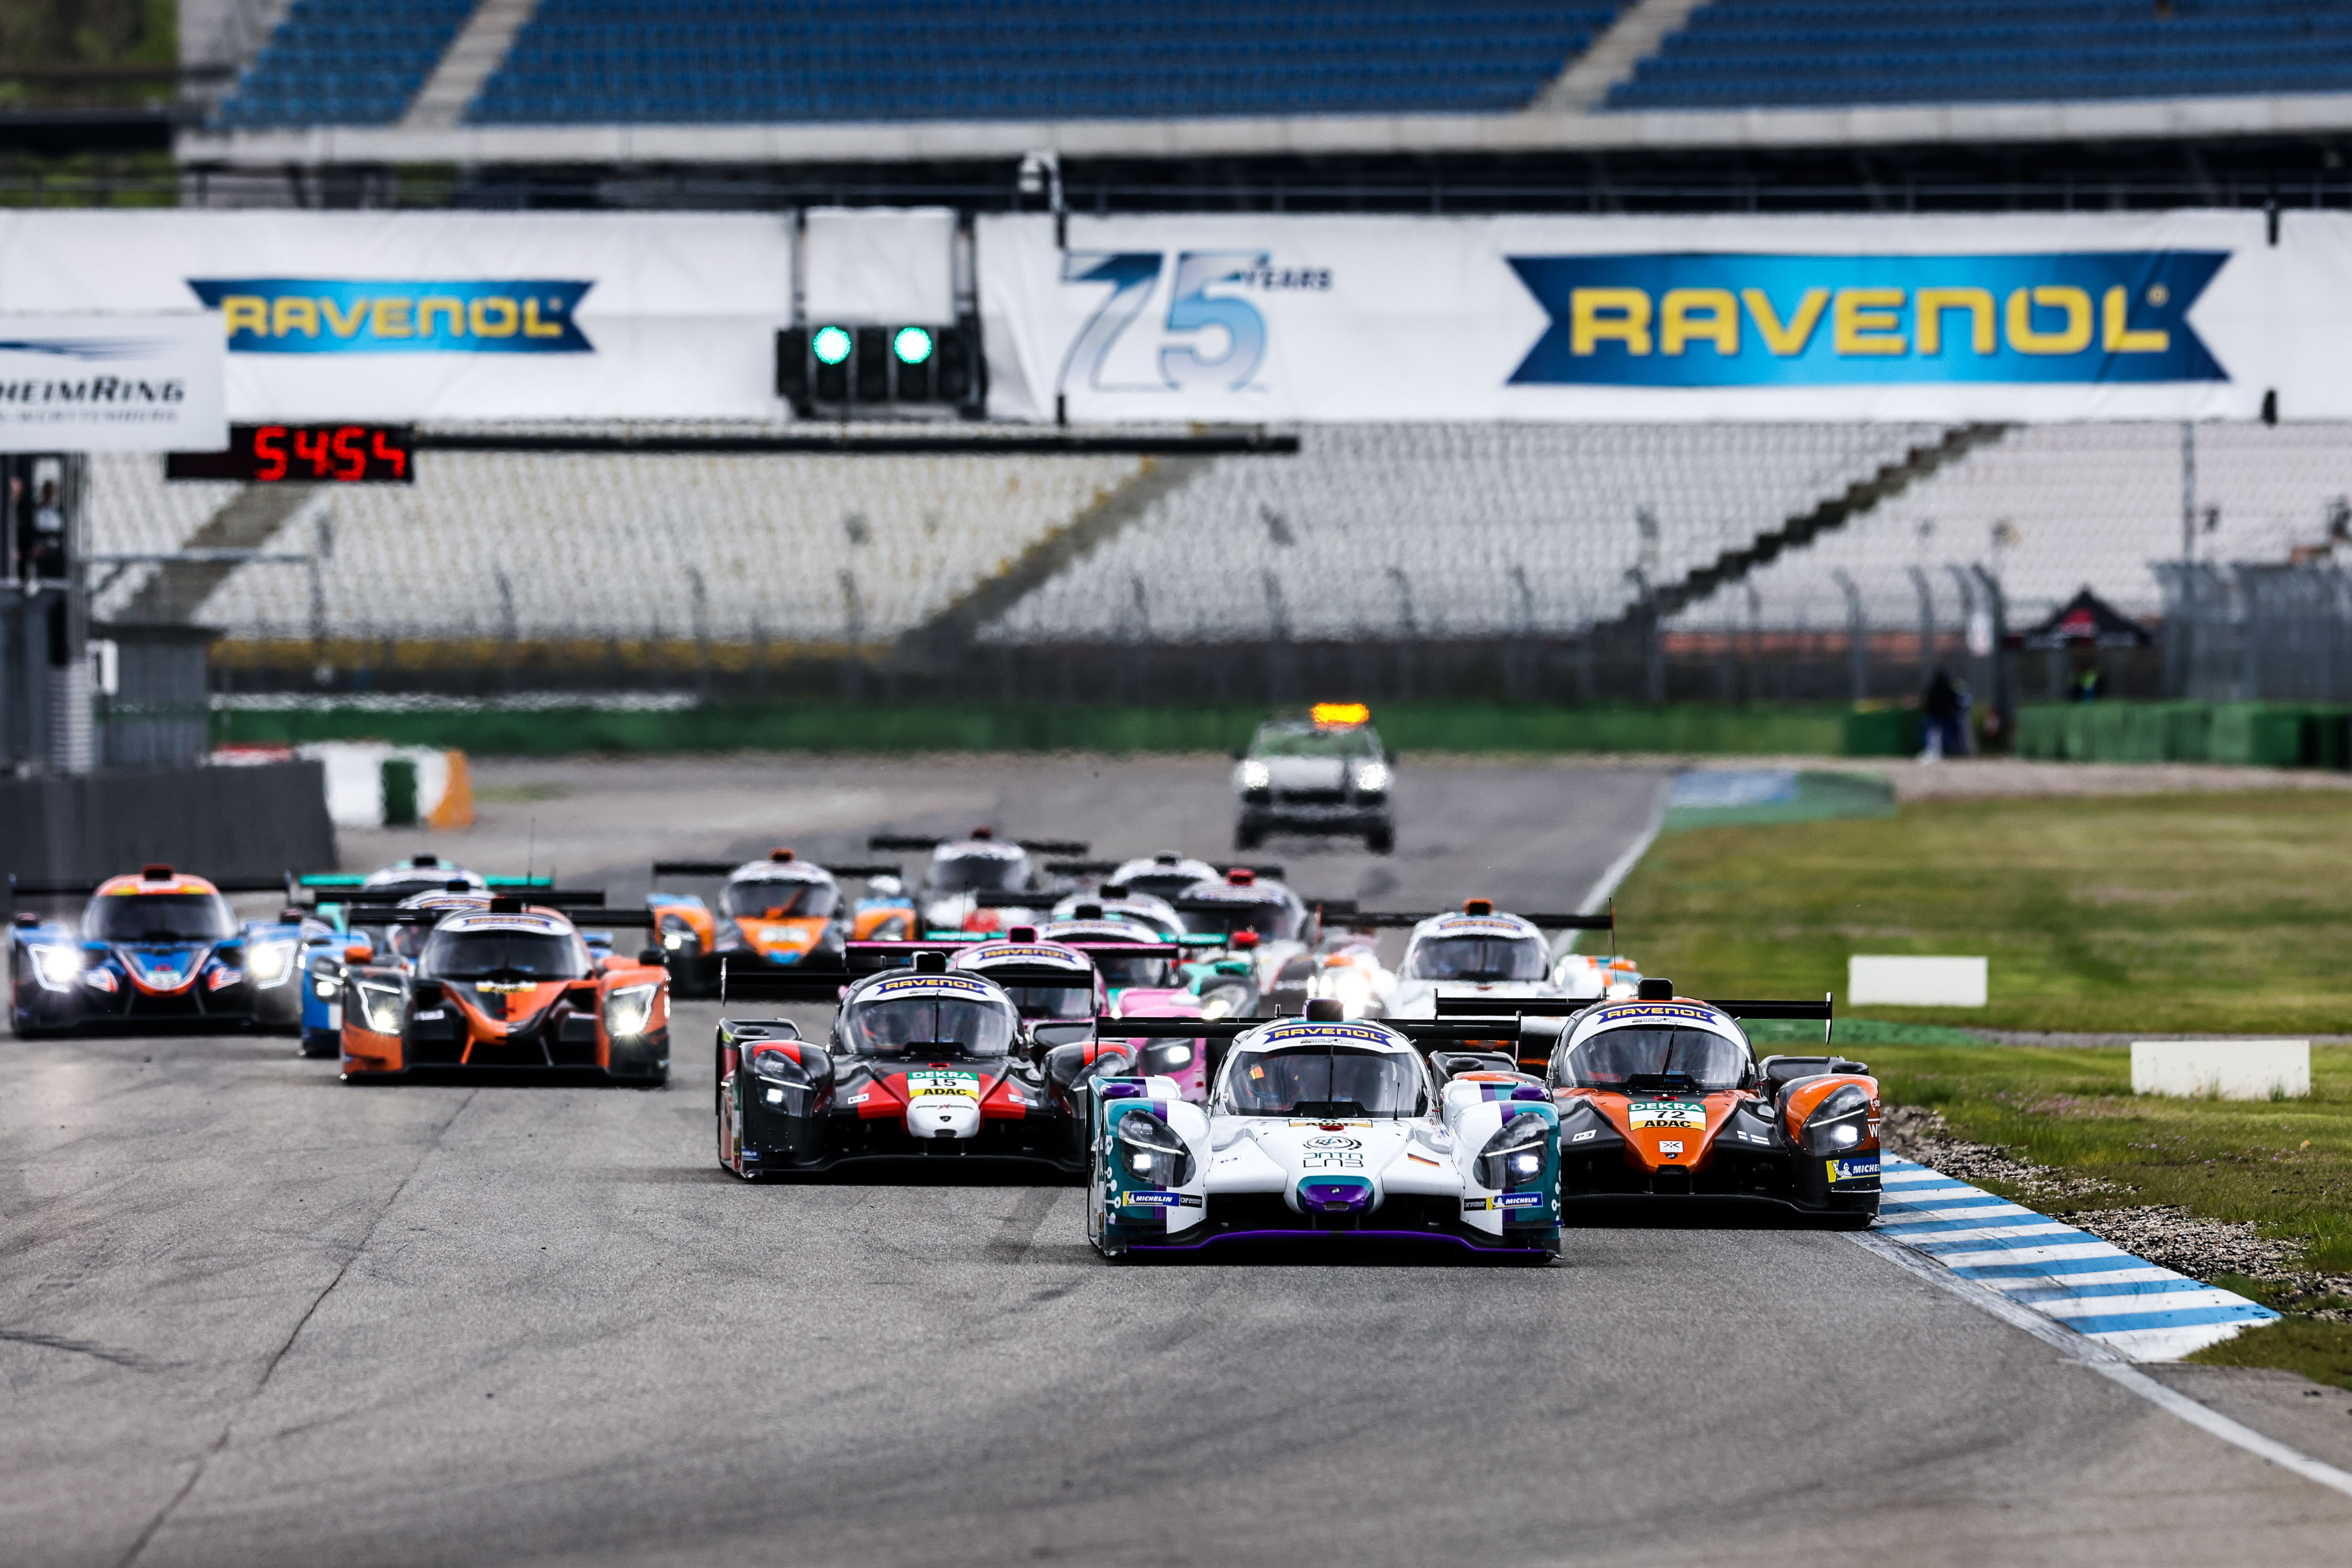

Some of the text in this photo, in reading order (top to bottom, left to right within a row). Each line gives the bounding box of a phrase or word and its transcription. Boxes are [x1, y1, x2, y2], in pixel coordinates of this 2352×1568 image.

[1058, 248, 1332, 392] 75 YEARS
[885, 979, 981, 990] RAVENOL
[1607, 1007, 1707, 1019] RAVENOL
[1275, 1028, 1382, 1041] RAVENOL
[1630, 1103, 1703, 1112] DEKRA
